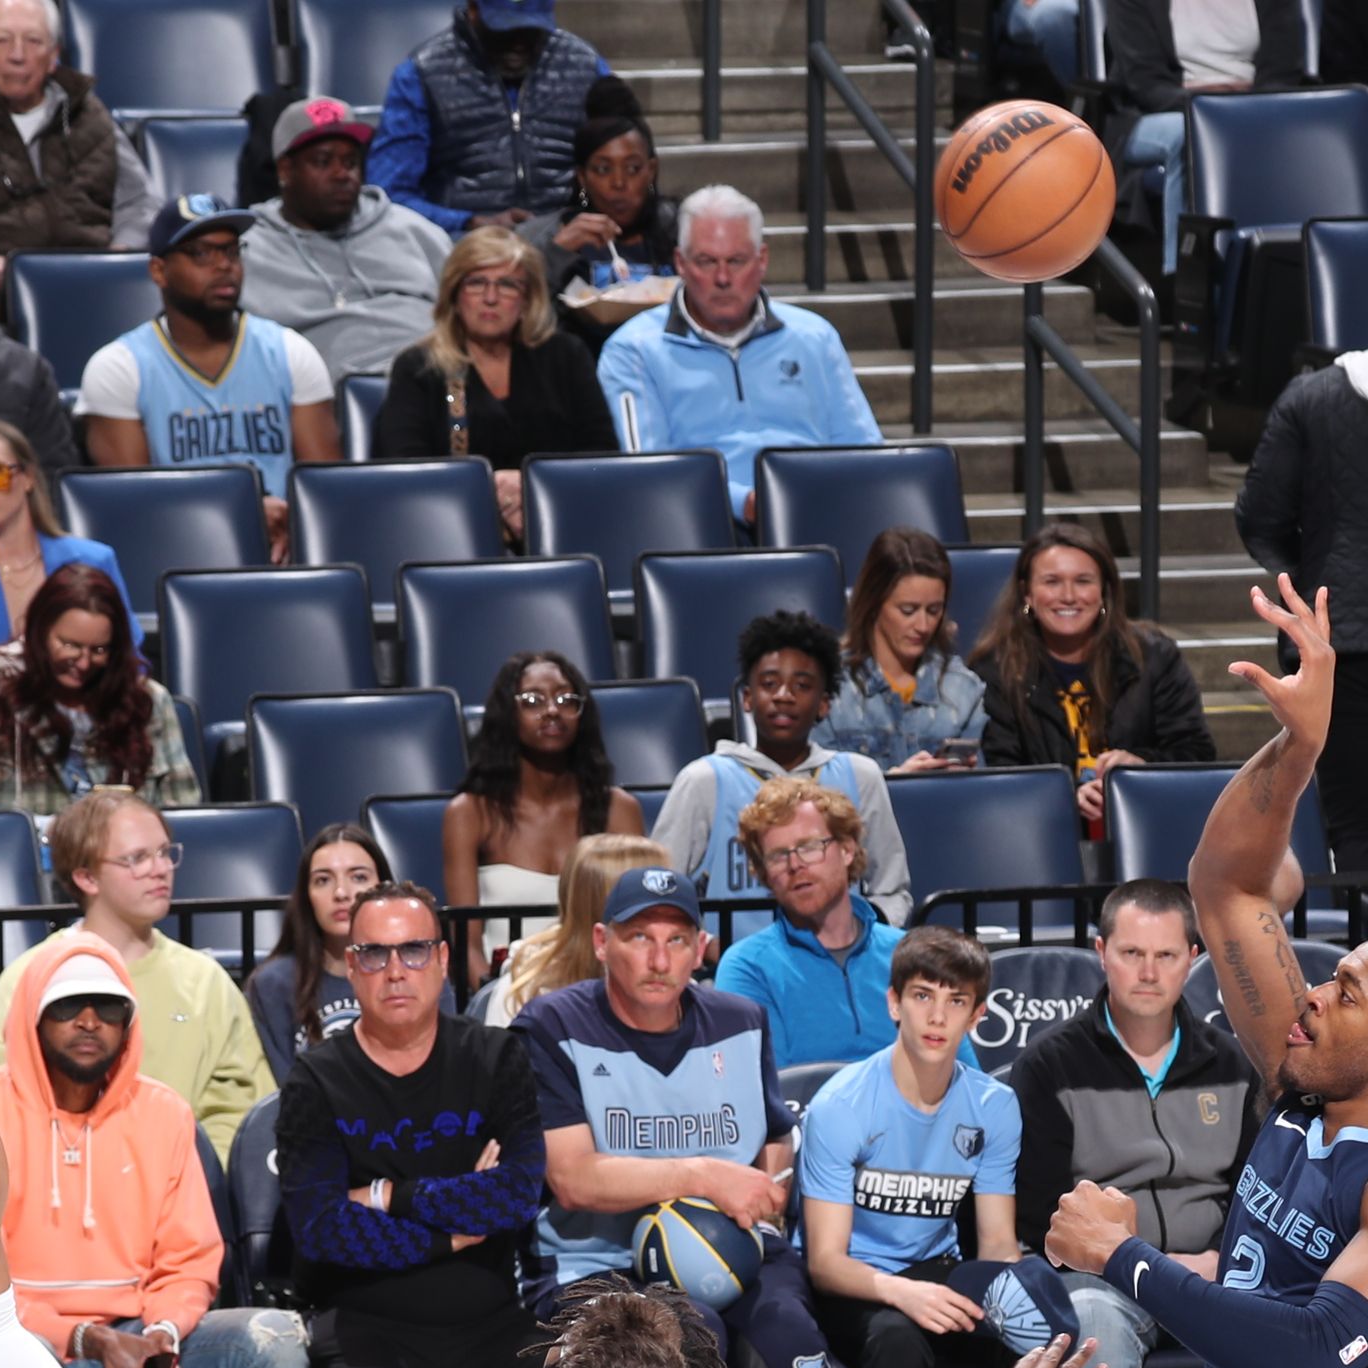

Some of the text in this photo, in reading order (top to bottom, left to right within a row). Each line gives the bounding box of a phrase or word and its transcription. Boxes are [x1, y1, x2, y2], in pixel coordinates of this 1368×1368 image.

[169, 404, 285, 463] GRIZZLIES
[1197, 1092, 1220, 1125] C
[605, 1103, 739, 1150] MEMPHIS
[858, 1169, 972, 1202] MEMPHIS
[855, 1191, 959, 1216] GRIZZLIE
